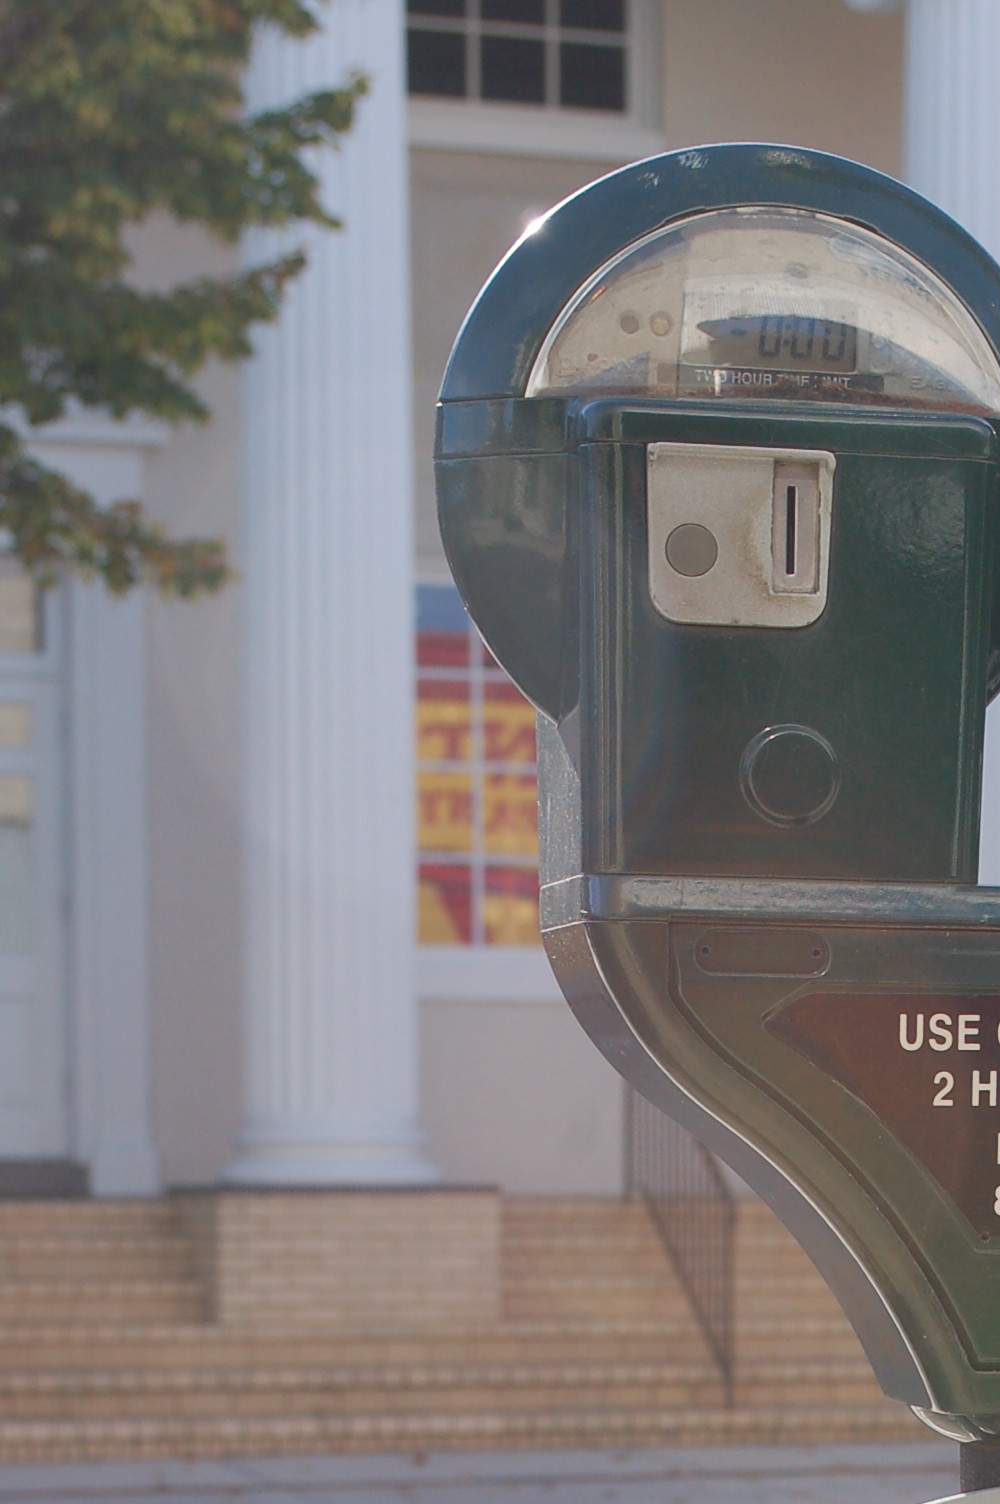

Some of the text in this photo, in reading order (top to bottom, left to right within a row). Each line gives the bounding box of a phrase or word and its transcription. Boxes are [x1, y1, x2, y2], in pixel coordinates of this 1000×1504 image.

[731, 371, 773, 386] HOUR
[898, 1013, 981, 1052] USE
[932, 1070, 955, 1107] 2
